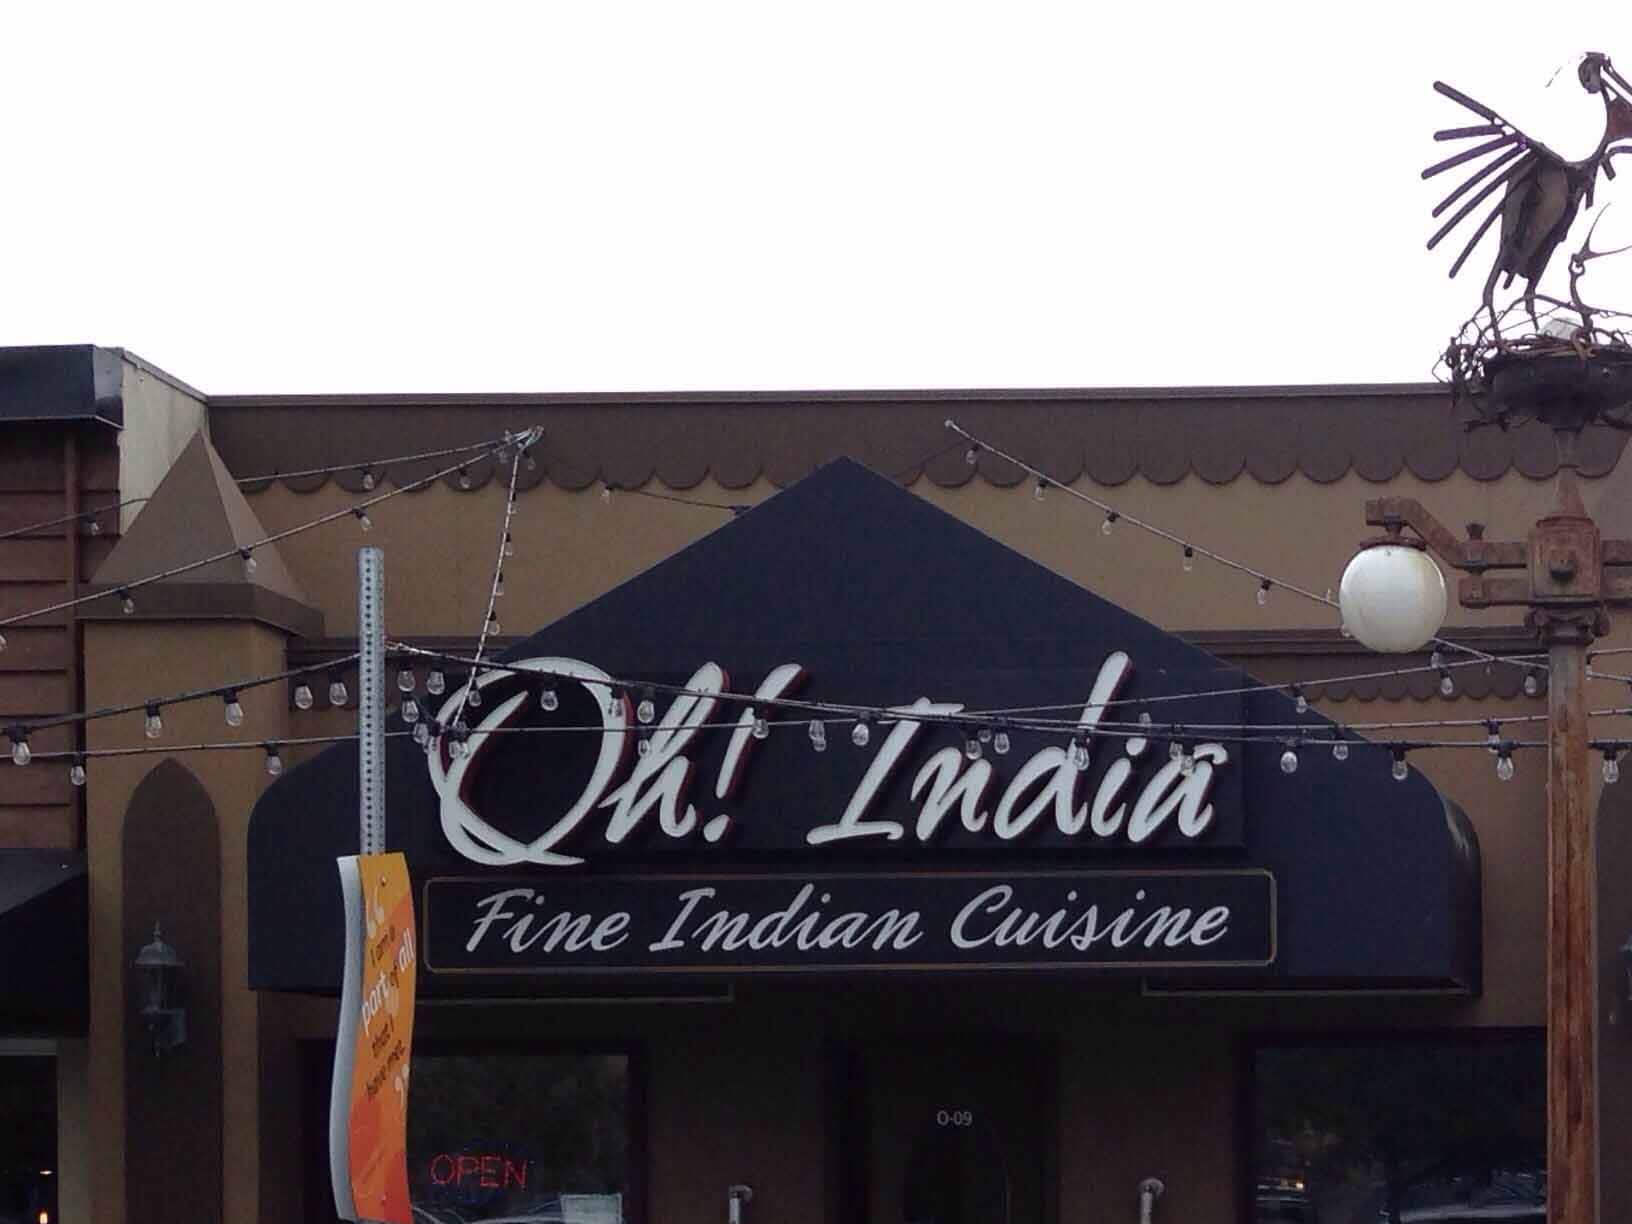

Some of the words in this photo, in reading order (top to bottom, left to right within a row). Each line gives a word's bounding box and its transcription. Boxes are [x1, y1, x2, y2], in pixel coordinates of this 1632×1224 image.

[428, 656, 802, 866] Oh!
[807, 652, 1228, 845] India
[466, 890, 631, 952] Fine
[650, 884, 923, 952] Indian
[951, 886, 1229, 952] Cuisine
[361, 970, 391, 1039] part
[398, 926, 416, 973] all
[431, 1153, 529, 1192] OPEN
